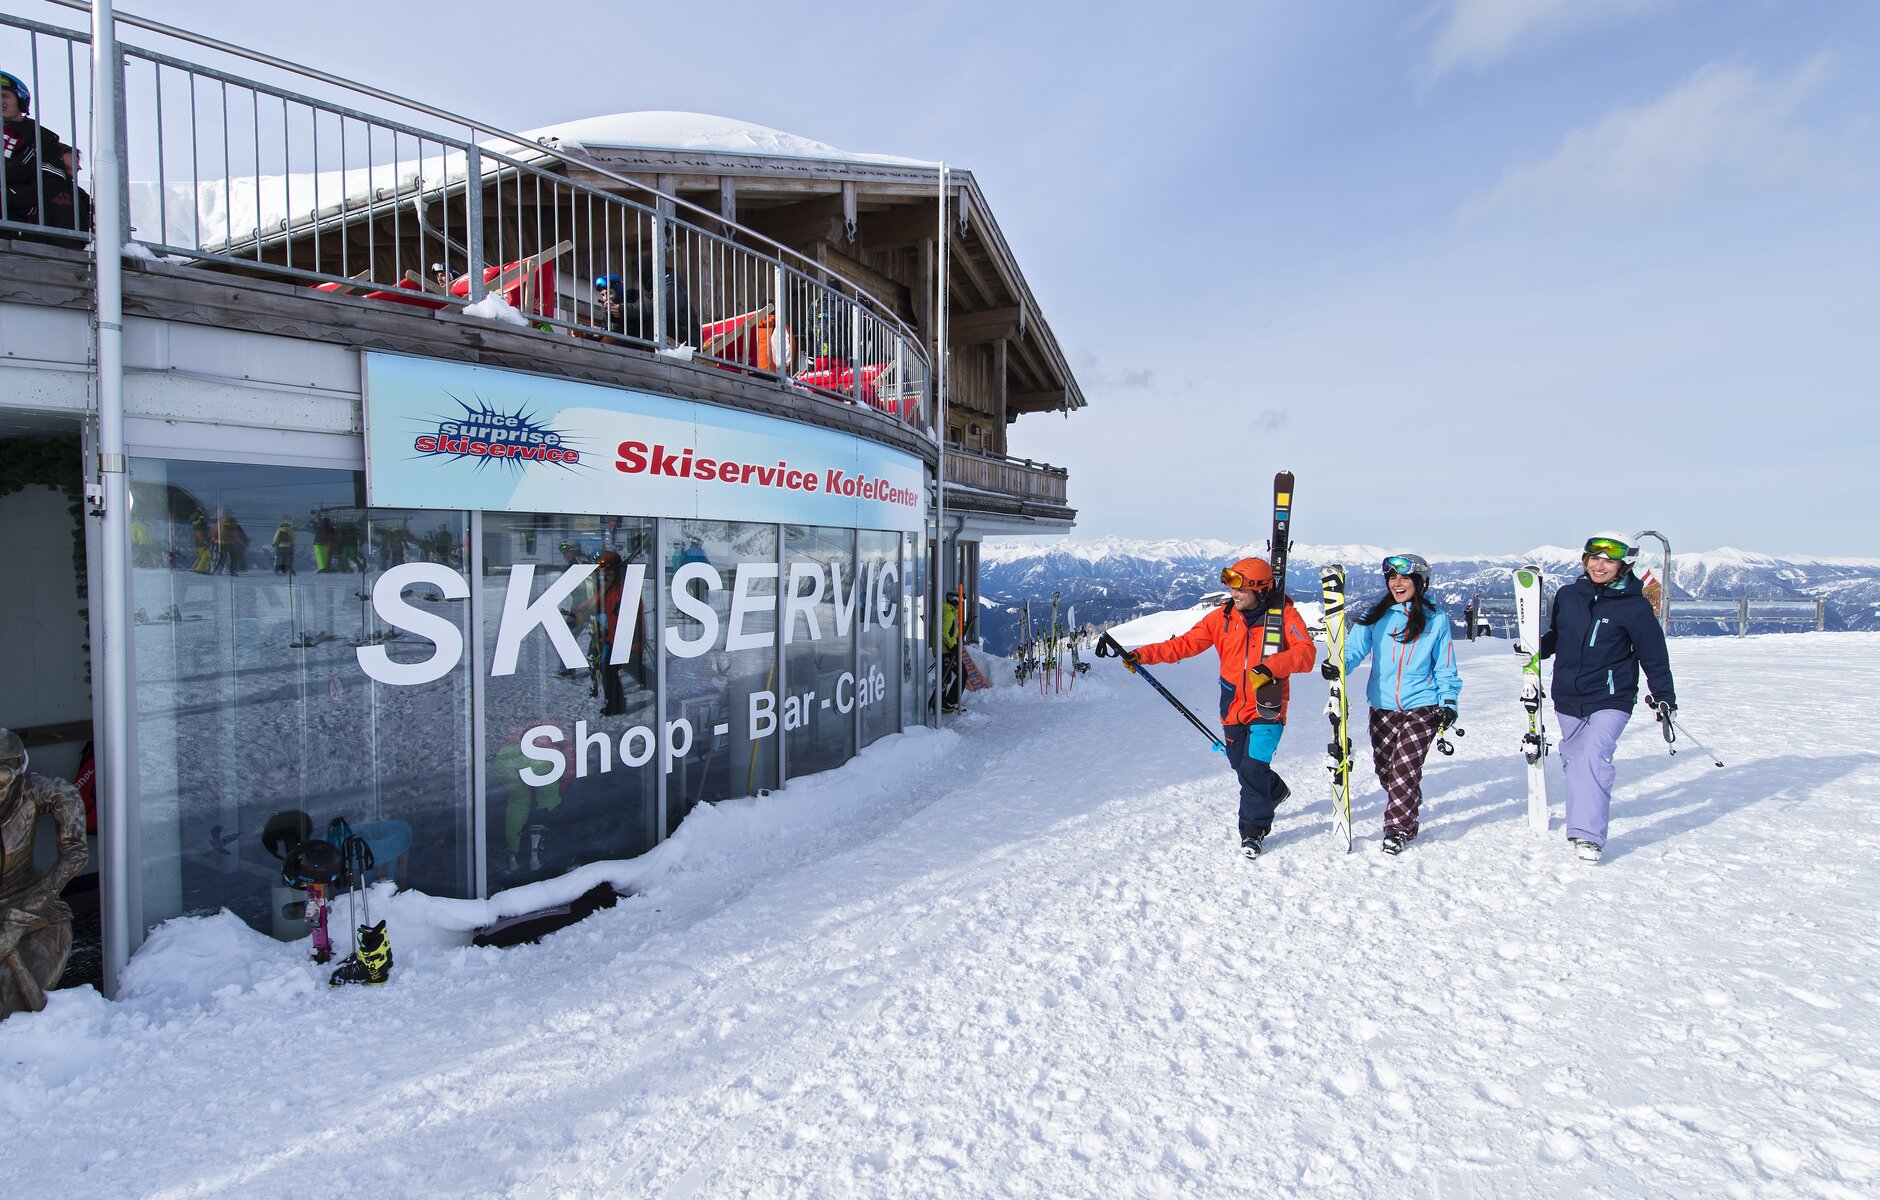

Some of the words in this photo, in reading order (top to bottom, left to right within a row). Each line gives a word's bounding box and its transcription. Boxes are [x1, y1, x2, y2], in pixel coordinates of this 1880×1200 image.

[469, 411, 519, 427] nice
[416, 434, 580, 464] skiservice
[441, 423, 560, 446] surprise
[615, 441, 818, 492] Skiservice
[825, 468, 918, 507] KofelCenter
[519, 718, 693, 787] Shop
